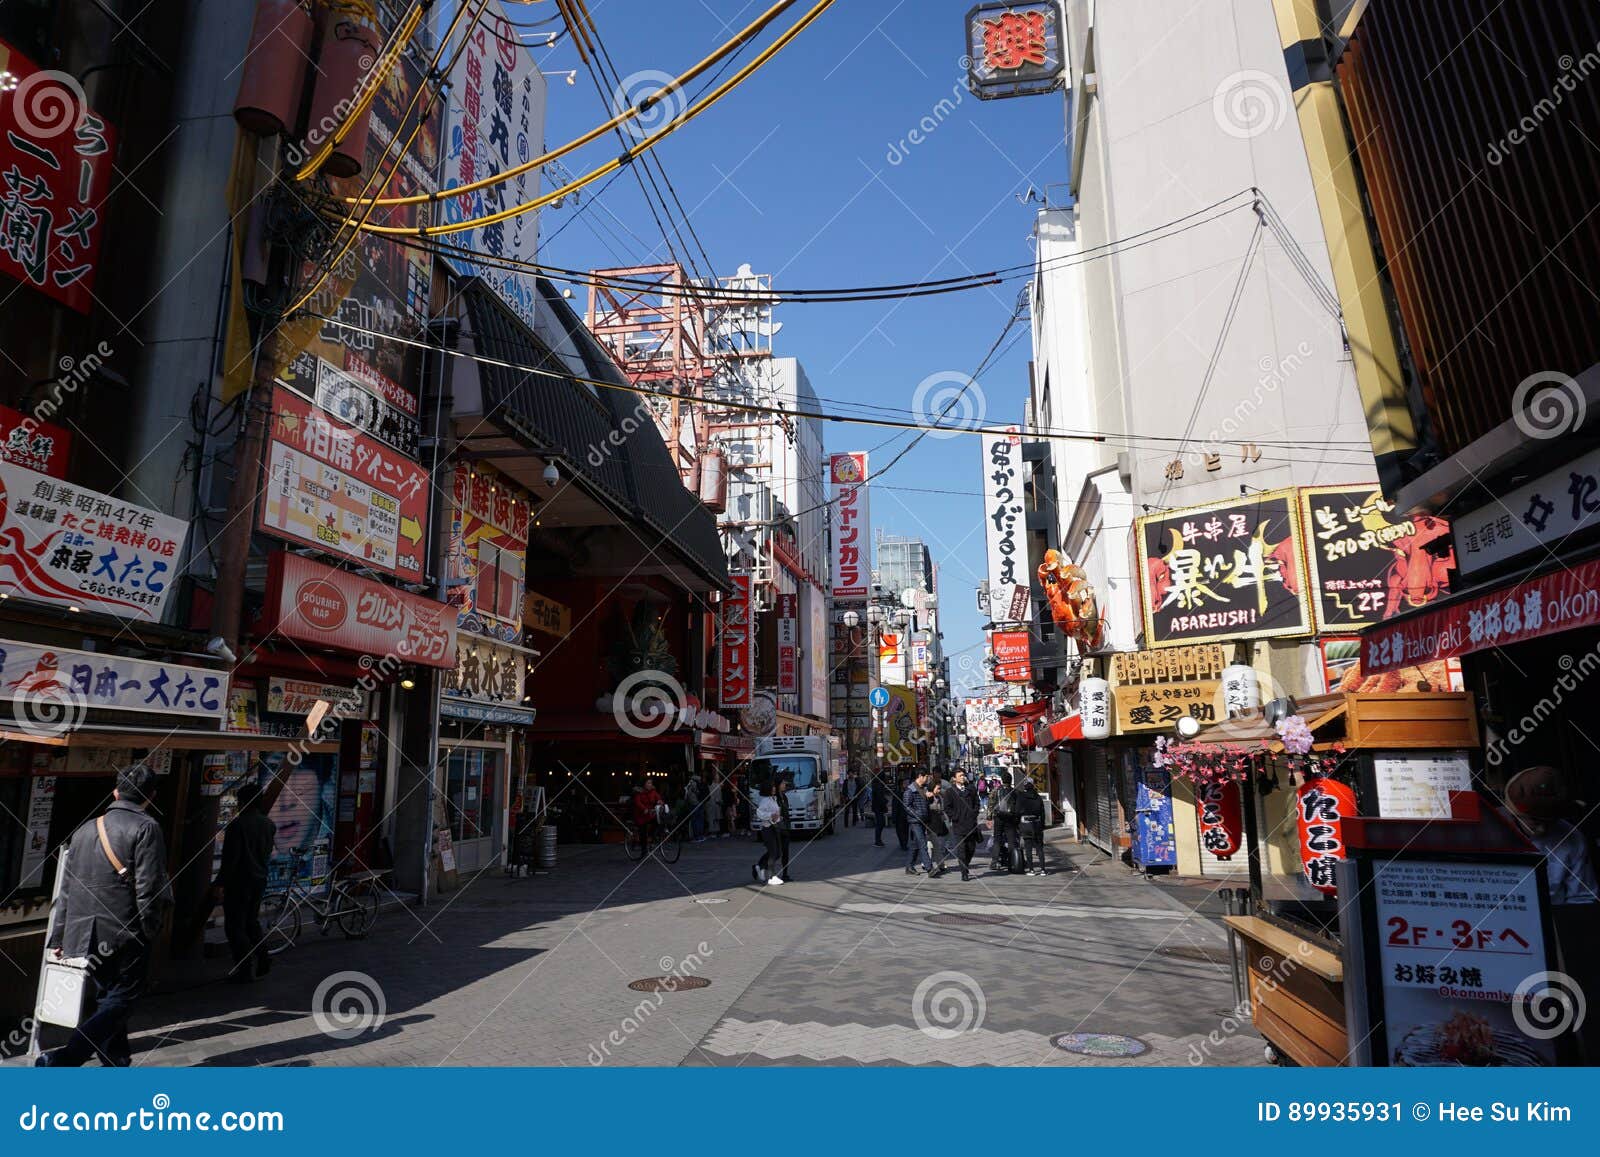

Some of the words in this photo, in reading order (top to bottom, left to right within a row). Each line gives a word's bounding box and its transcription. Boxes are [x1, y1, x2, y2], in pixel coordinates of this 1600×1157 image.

[0, 131, 60, 286] 一蘭
[53, 113, 109, 287] ラーメン
[303, 411, 425, 499] 相席ダイニング
[32, 480, 156, 531] 創業昭和47年
[990, 439, 1023, 585] 串かつだるま
[14, 499, 59, 524] 道頓堀
[60, 510, 178, 557] たこ焼発祥の店
[839, 485, 859, 587] ジャンカラ
[1181, 513, 1250, 545] 牛串屋
[1466, 514, 1514, 555] 道頓堀
[50, 544, 94, 575] 本家
[91, 546, 169, 593] 大たこ
[1161, 540, 1284, 618] 暴れ牛
[303, 592, 341, 611] GOURMET
[311, 606, 331, 619] MAP
[1170, 608, 1257, 633] ABAREUSHI
[1357, 591, 1386, 612] 2F
[1368, 631, 1405, 668] たこ焼
[1405, 619, 1463, 659] takoyaki
[1468, 589, 1543, 643] お好み焼
[1154, 650, 1165, 675] つくね
[69, 663, 220, 711] 日本一大たこ
[1138, 687, 1202, 704] 炭火やきとり
[1091, 691, 1105, 728] 愛之助
[1129, 702, 1216, 726] 愛之助
[1394, 963, 1483, 988] お好み焼
